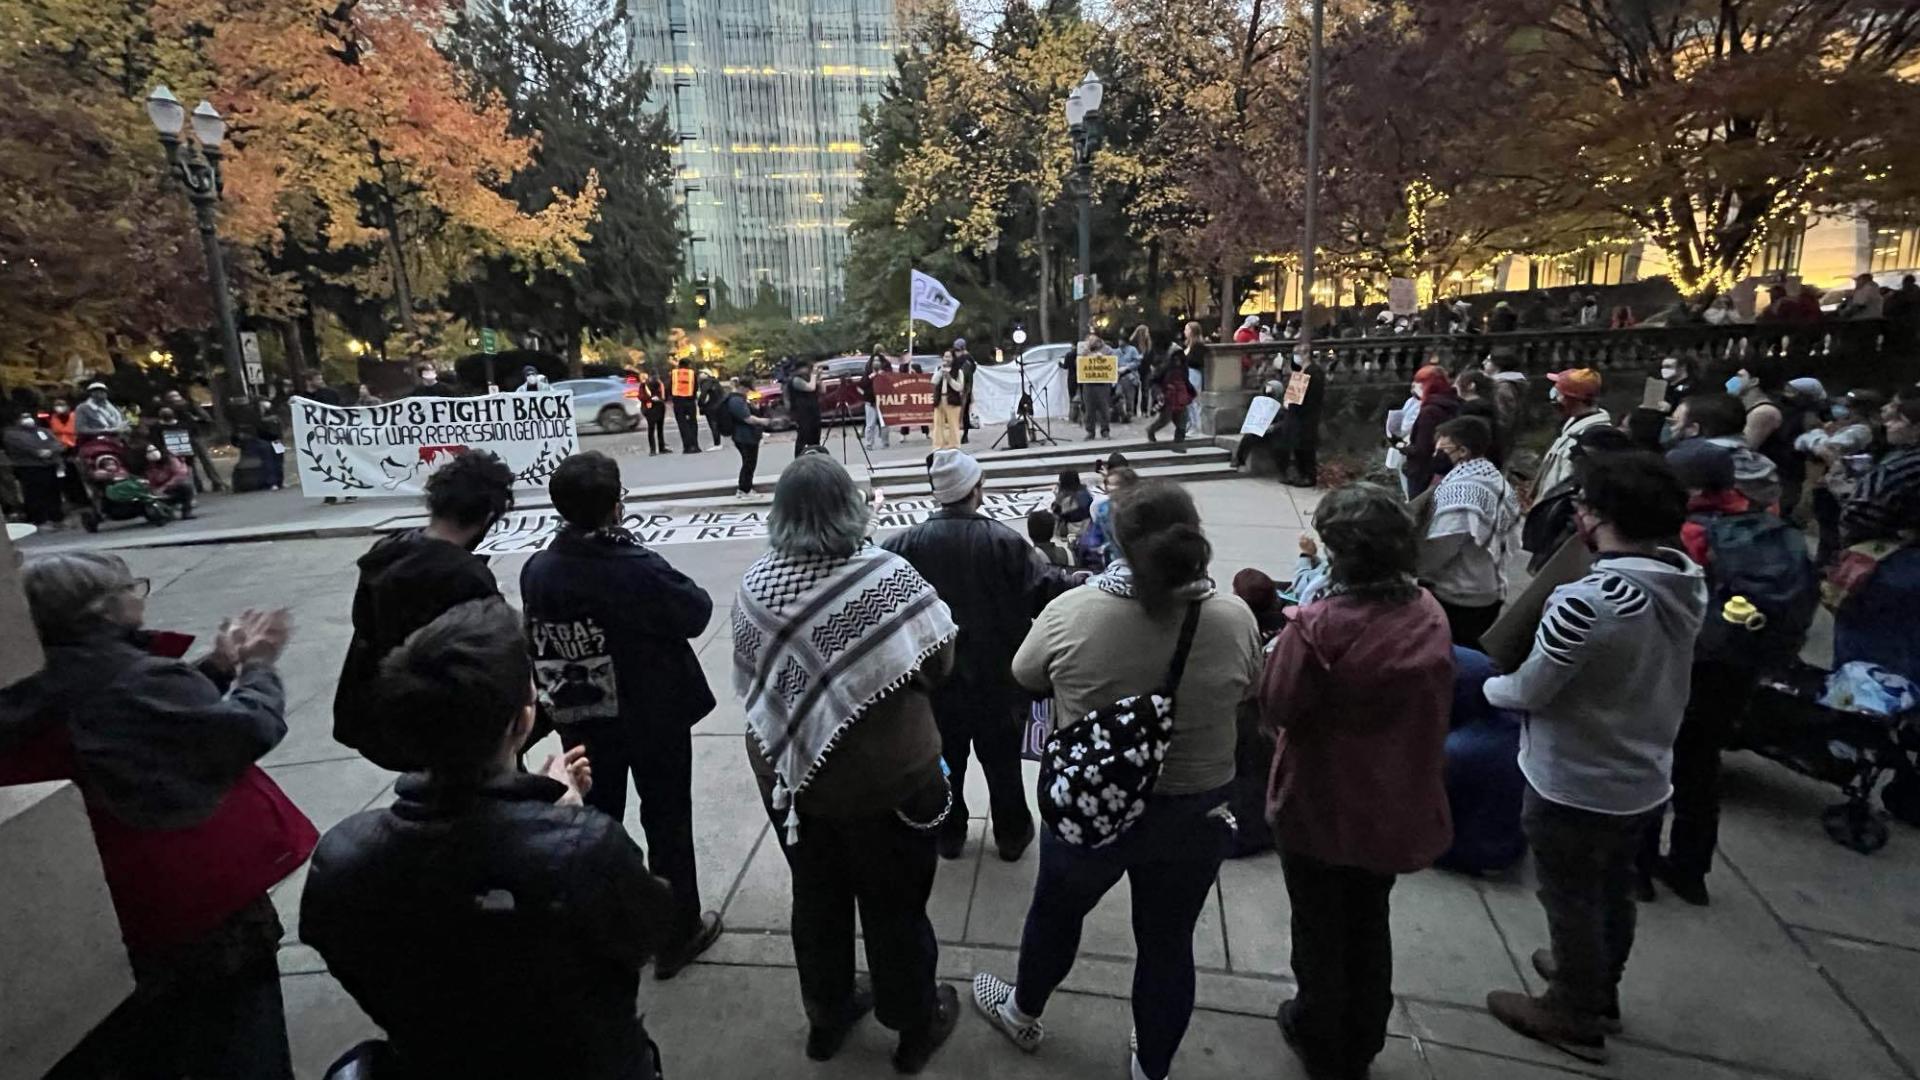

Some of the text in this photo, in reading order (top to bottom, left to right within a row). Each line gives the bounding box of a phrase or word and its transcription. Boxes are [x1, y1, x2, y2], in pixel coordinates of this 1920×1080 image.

[302, 394, 572, 427] RISE UP & FIGHT BACK
[876, 393, 935, 406] HALF THE
[314, 425, 382, 446] AGAINST
[515, 418, 573, 441] GENOCIDE
